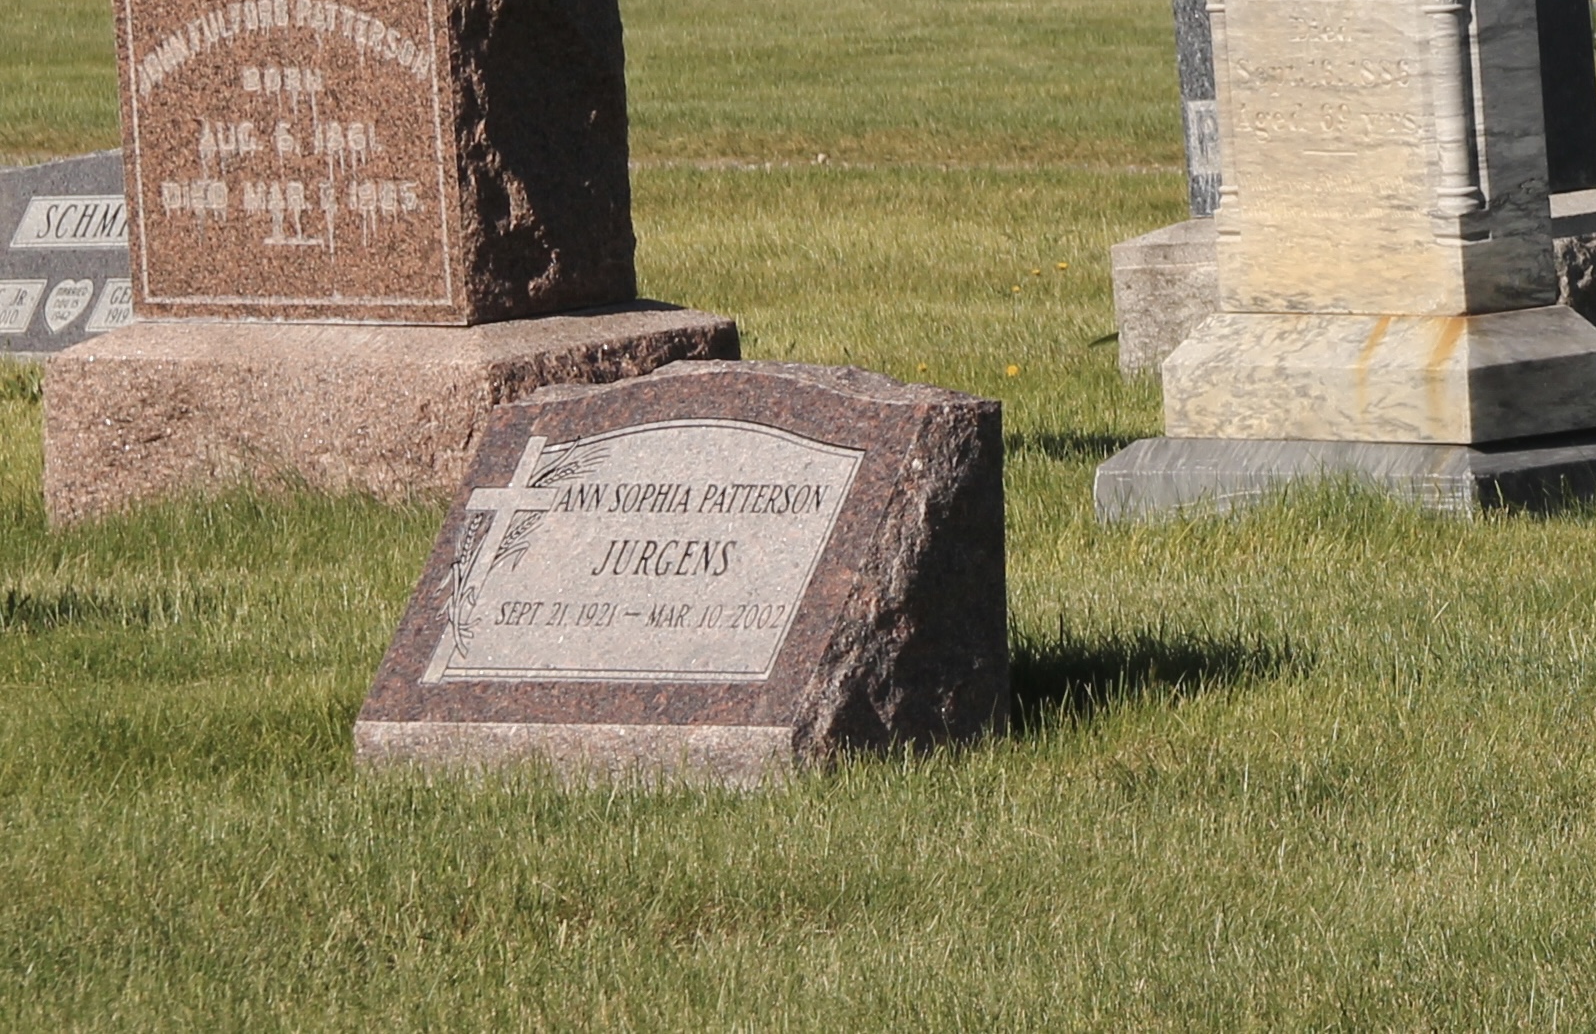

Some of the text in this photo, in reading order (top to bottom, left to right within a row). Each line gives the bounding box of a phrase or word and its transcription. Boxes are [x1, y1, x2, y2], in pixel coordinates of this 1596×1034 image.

[242, 66, 323, 92] BORN
[161, 180, 229, 210] DIED
[0, 309, 19, 325] 010
[553, 482, 833, 515] ANN SOPHIA PATTERSON
[590, 539, 739, 577] JURGENS
[573, 602, 621, 627] 1921
[730, 604, 786, 630] 2002
